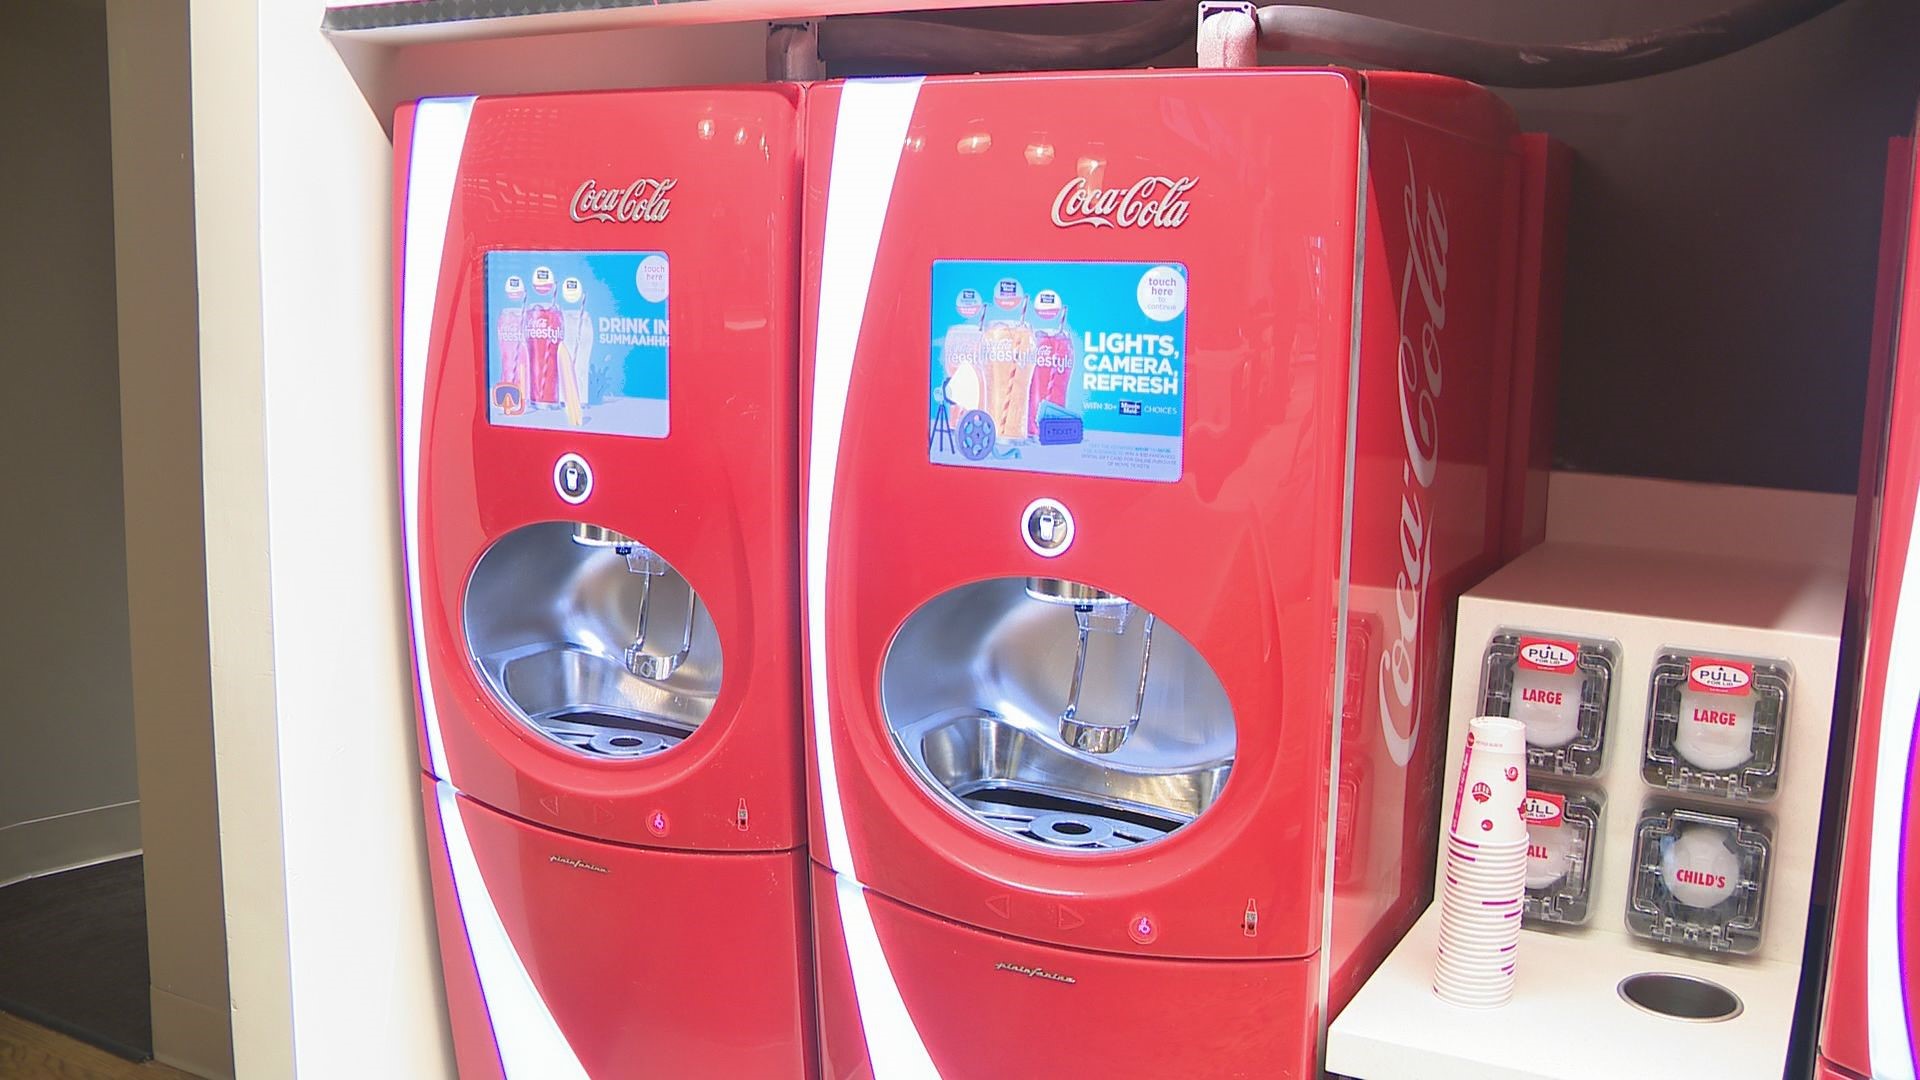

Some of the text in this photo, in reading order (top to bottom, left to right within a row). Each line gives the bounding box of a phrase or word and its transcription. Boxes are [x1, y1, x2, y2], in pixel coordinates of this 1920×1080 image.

[569, 178, 679, 223] Coca-Cola
[1051, 176, 1200, 228] Coca-Cola
[644, 265, 665, 273] touch
[1149, 277, 1177, 287] touch
[1151, 286, 1174, 296] here
[599, 317, 669, 335] DRINK IN
[1084, 331, 1180, 359] LIGHTS,
[1083, 353, 1179, 378] CAMERA,
[1082, 372, 1179, 395] REFRESH
[1083, 401, 1102, 410] WITH
[1144, 405, 1178, 415] CHOICES
[1378, 136, 1449, 768] Coca-Cola
[1528, 648, 1569, 662] PULL
[1699, 670, 1743, 683] PULL
[1522, 687, 1563, 705] LARGE
[1693, 708, 1737, 726] LARGE
[1526, 803, 1554, 815] ULL
[1526, 844, 1548, 859] ALL
[1676, 869, 1726, 889] CHILD'S
